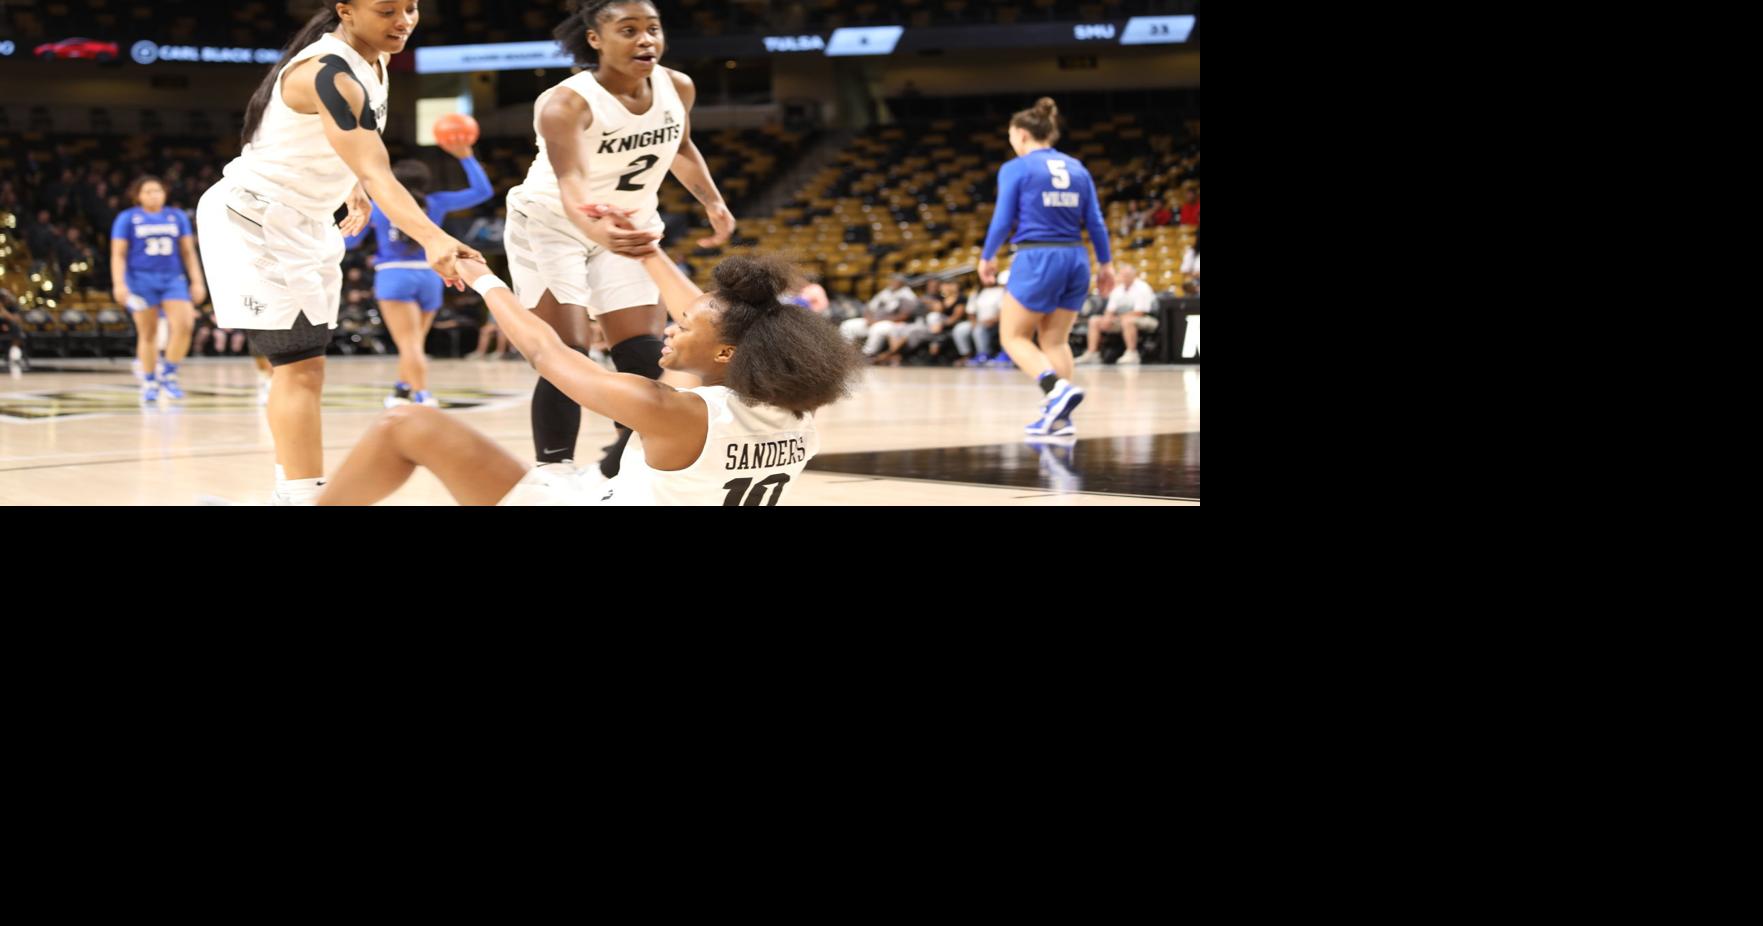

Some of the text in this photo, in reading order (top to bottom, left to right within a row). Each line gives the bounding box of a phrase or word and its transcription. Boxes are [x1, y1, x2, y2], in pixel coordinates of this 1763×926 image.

[763, 35, 825, 52] TULSA
[1074, 24, 1116, 39] SMU
[158, 45, 199, 61] CARL
[201, 46, 252, 63] BLACK
[597, 124, 680, 153] KNIGHTS
[615, 154, 659, 191] 2
[1046, 159, 1070, 190] 5
[1042, 191, 1080, 207] WILSON
[145, 236, 173, 256] 33
[725, 437, 806, 470] SANDERS
[722, 473, 791, 506] 10
